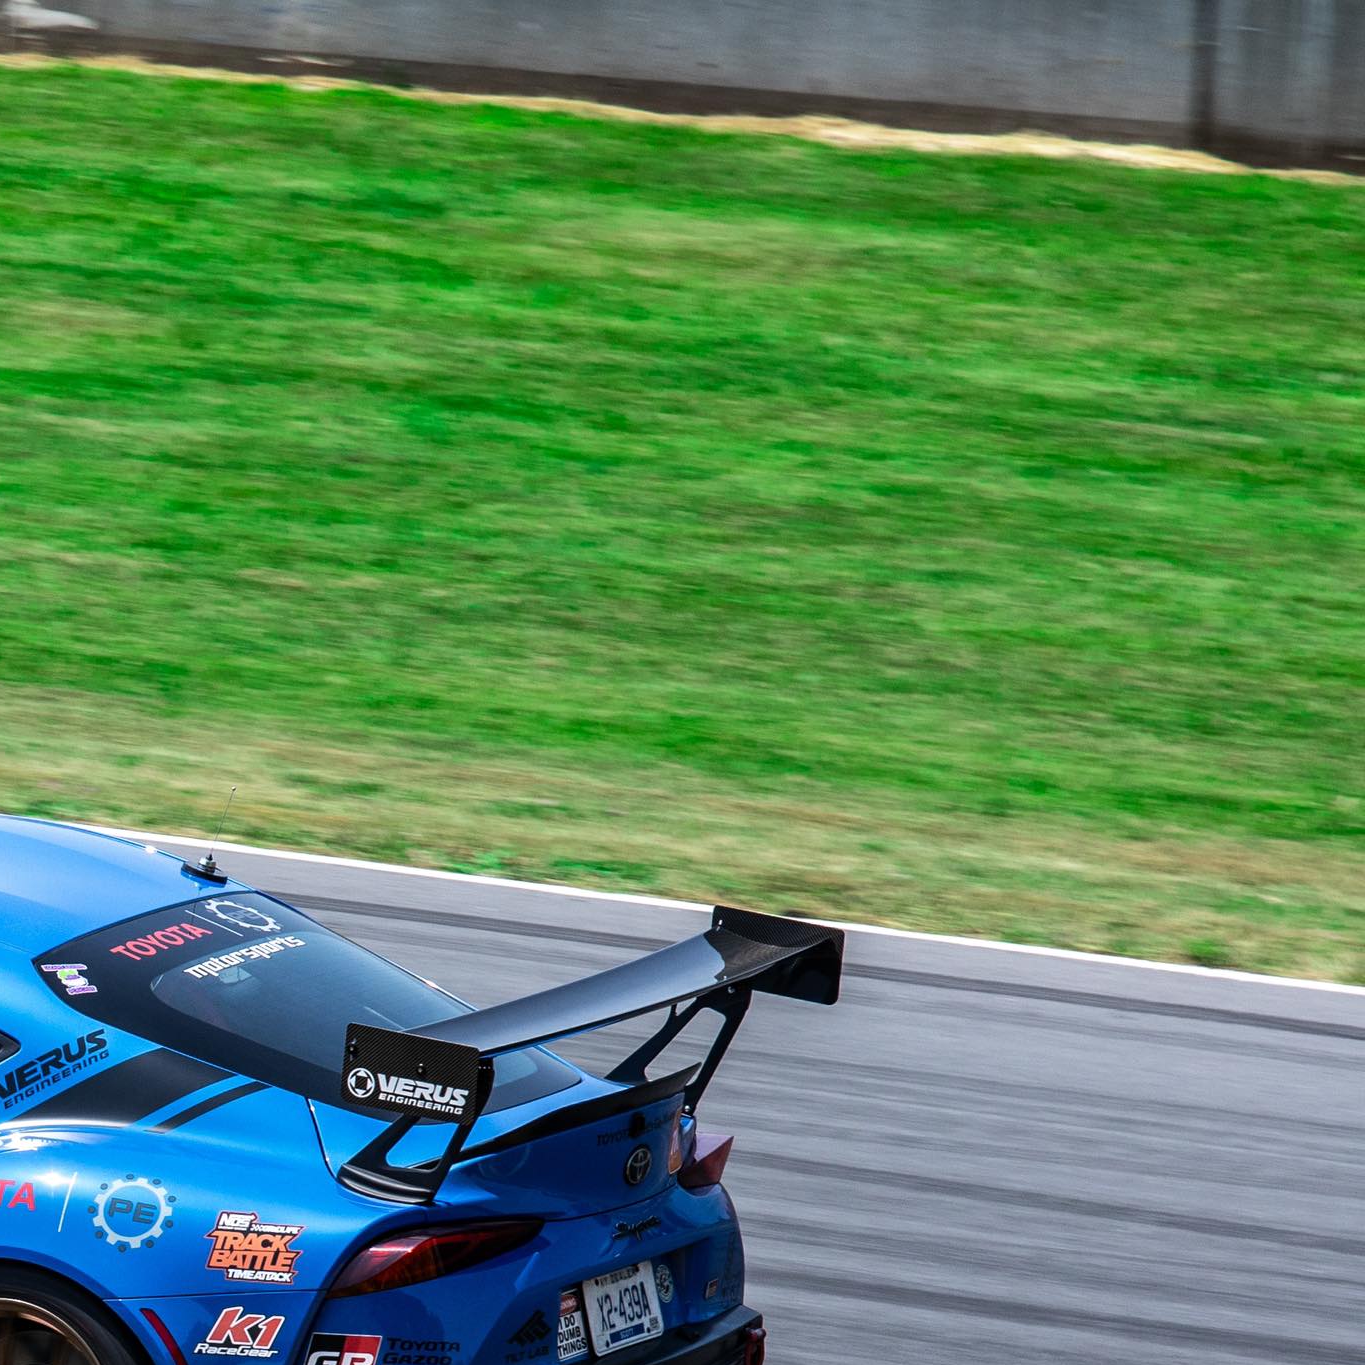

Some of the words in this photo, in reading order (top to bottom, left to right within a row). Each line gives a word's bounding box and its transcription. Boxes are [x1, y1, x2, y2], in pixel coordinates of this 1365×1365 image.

[109, 922, 213, 961] TOYOTA
[183, 936, 306, 979] motorsports
[377, 1072, 469, 1107] VERUS
[109, 1197, 157, 1225] PE
[208, 1230, 294, 1252] TRACK
[208, 1250, 300, 1272] BATTLE
[206, 1306, 286, 1349] K1
[565, 1315, 576, 1329] DO
[387, 1337, 461, 1353] TOYOTA
[558, 1328, 581, 1343] DUMB
[193, 1343, 279, 1358] RaceGear
[557, 1337, 588, 1358] THINGS
